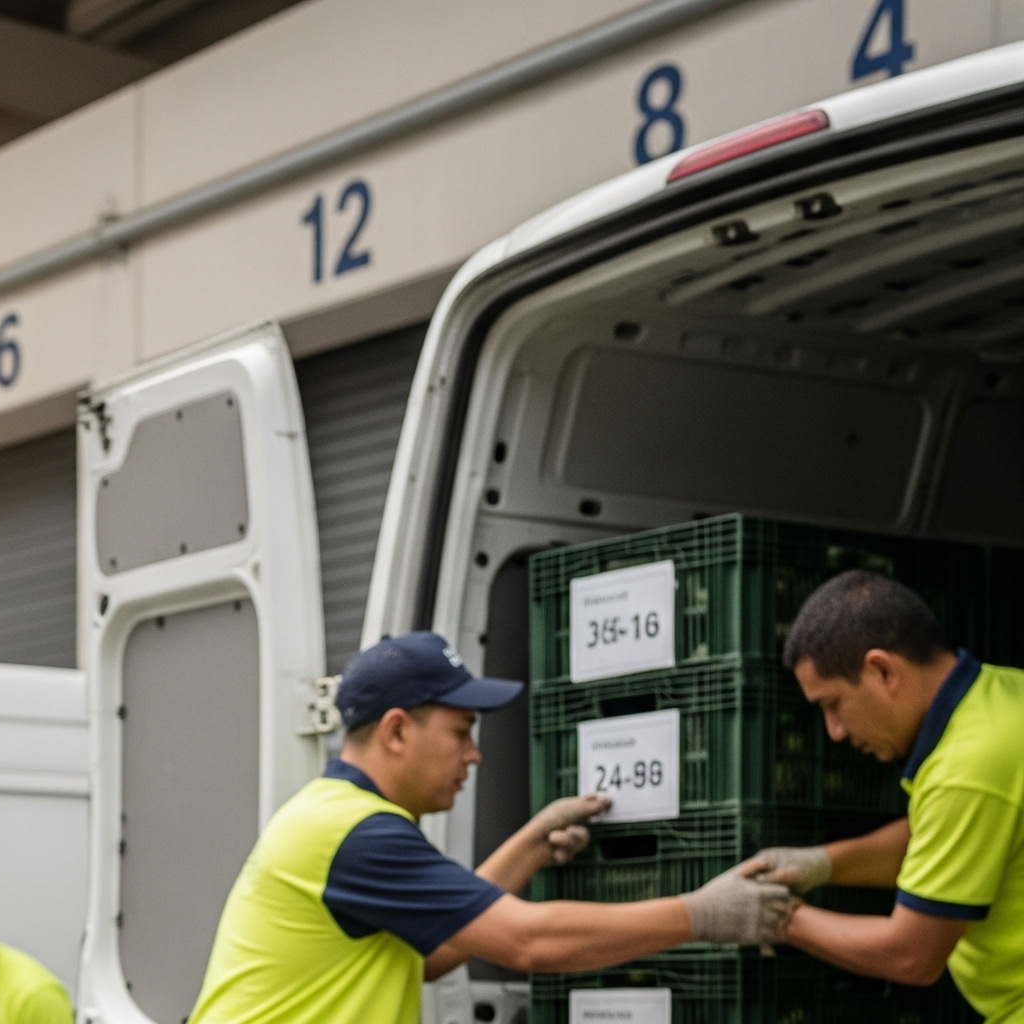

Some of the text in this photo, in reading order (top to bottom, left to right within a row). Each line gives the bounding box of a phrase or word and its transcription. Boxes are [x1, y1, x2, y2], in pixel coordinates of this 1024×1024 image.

[850, 0, 917, 82] 4
[634, 62, 687, 166] 8
[300, 178, 371, 284] 12
